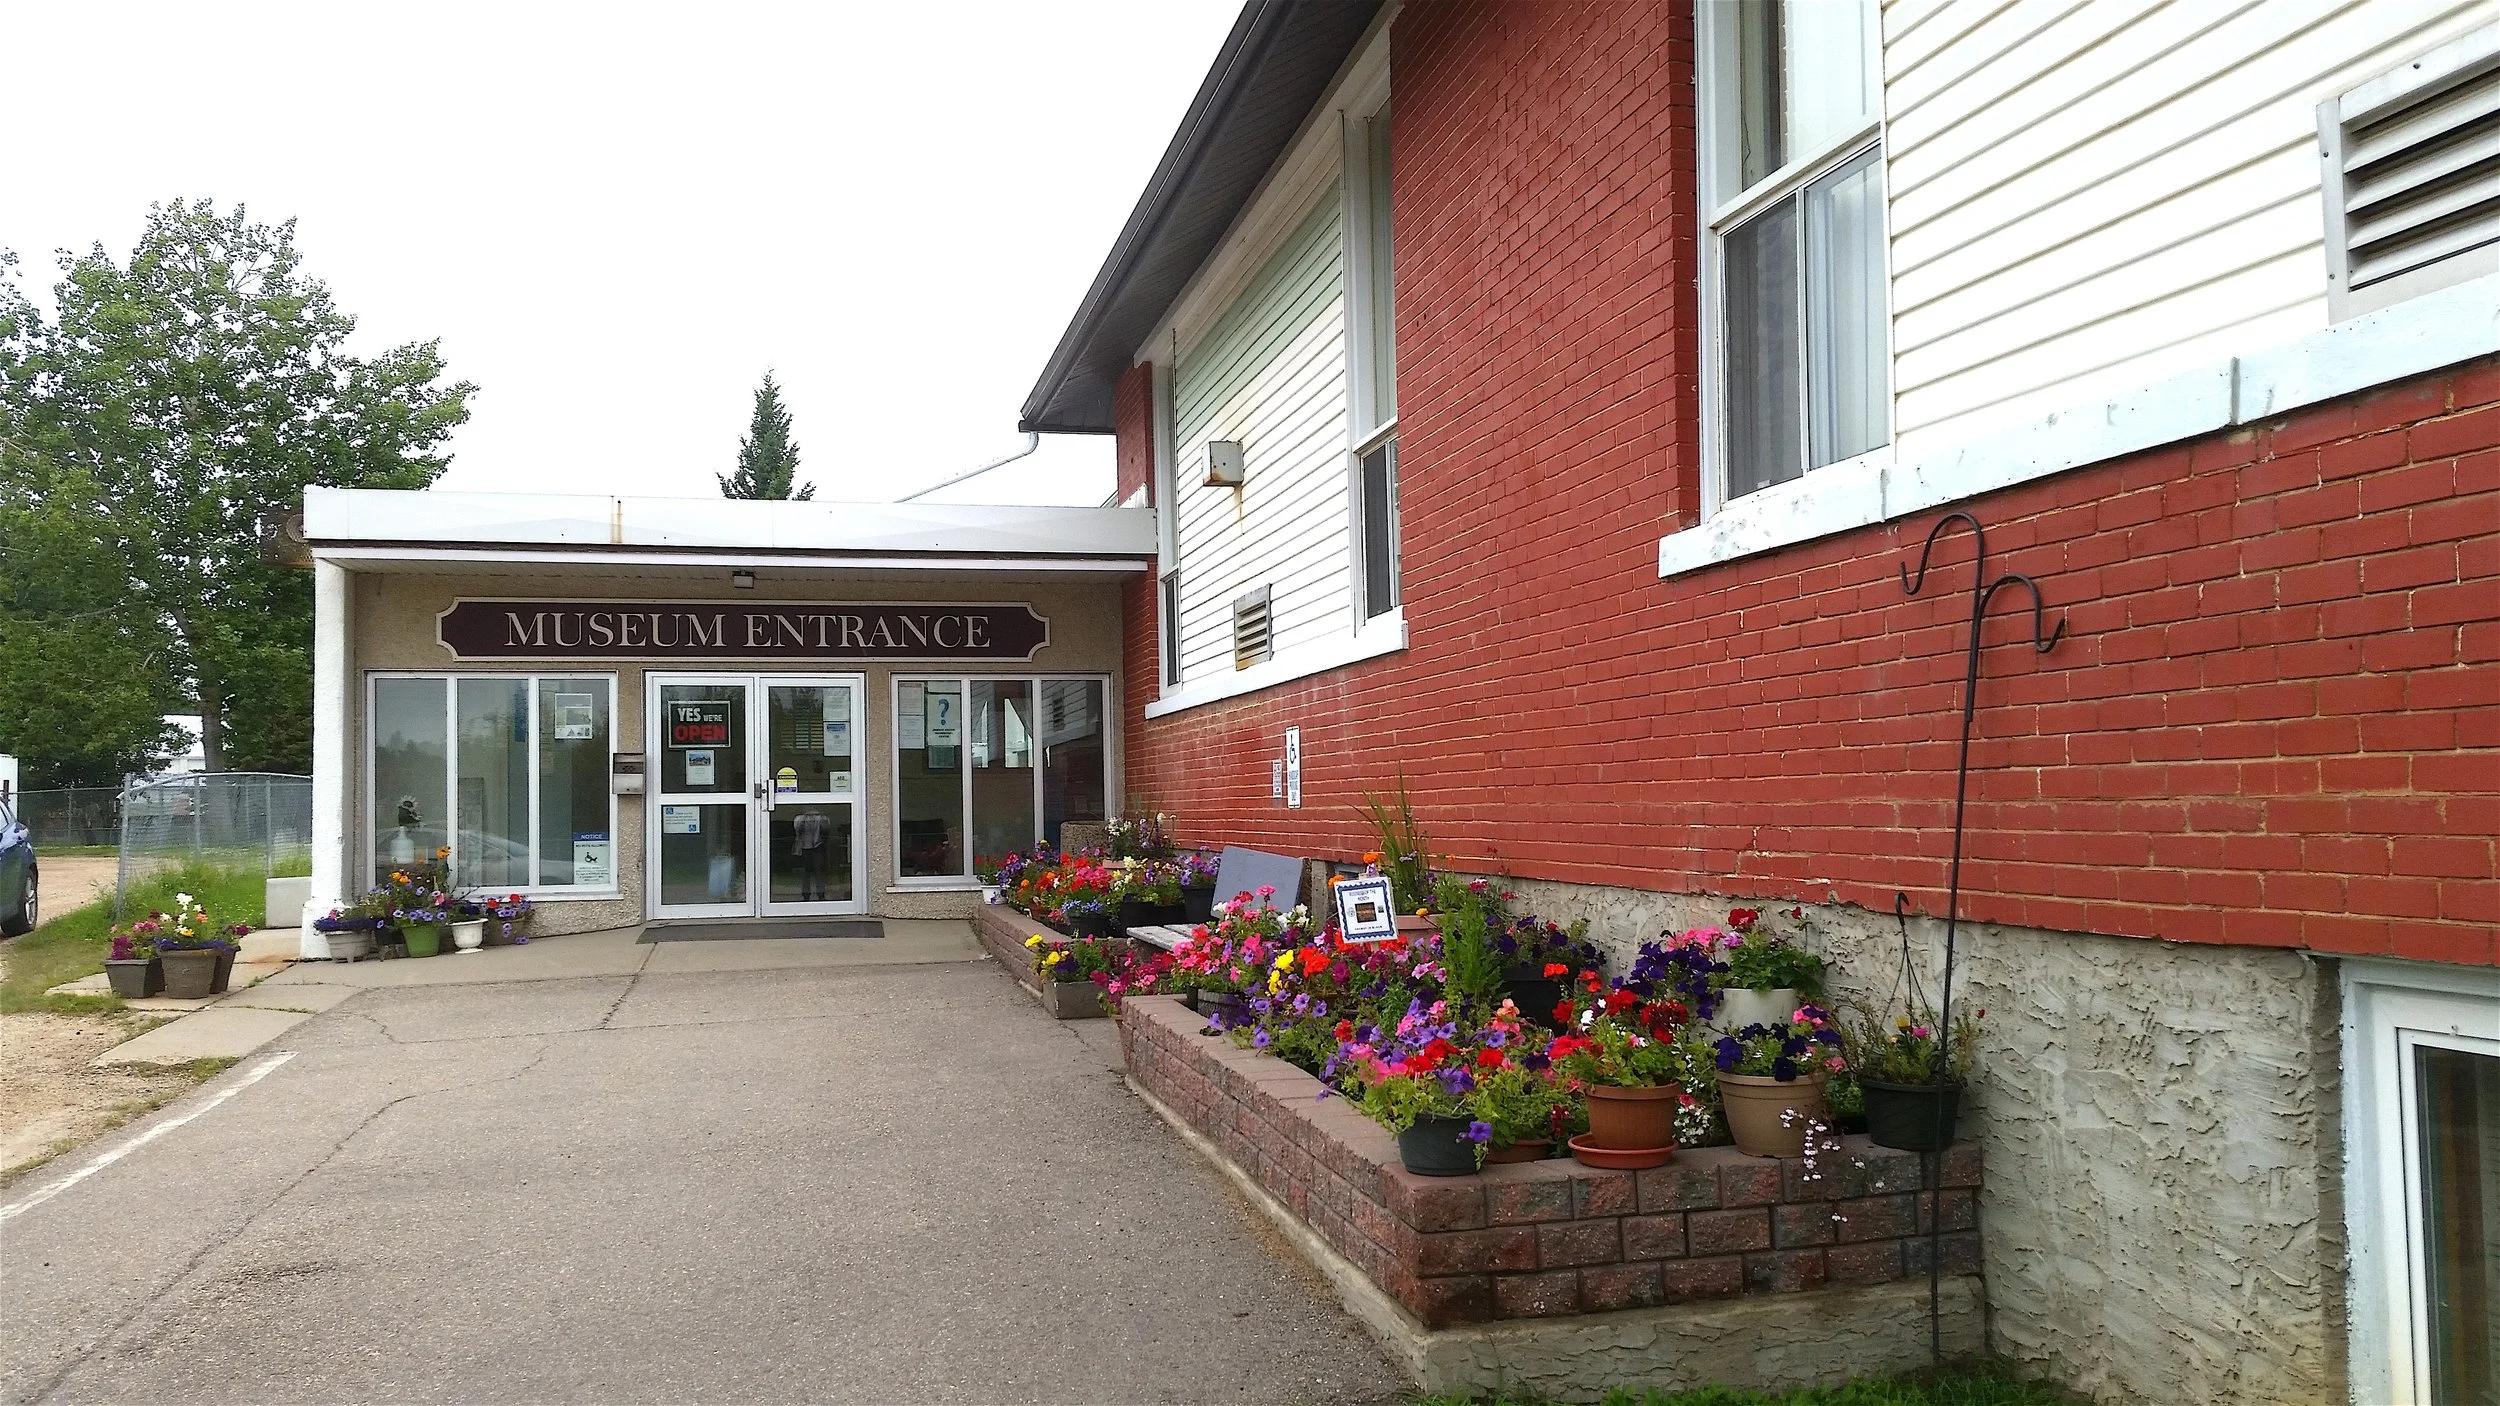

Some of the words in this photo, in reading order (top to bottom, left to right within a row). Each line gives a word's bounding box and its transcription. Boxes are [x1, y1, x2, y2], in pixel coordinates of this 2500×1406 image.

[504, 612, 727, 647] MUSEUM
[743, 614, 990, 648] ENTRANCE
[677, 707, 701, 721] YES
[674, 724, 727, 742] OPEN
